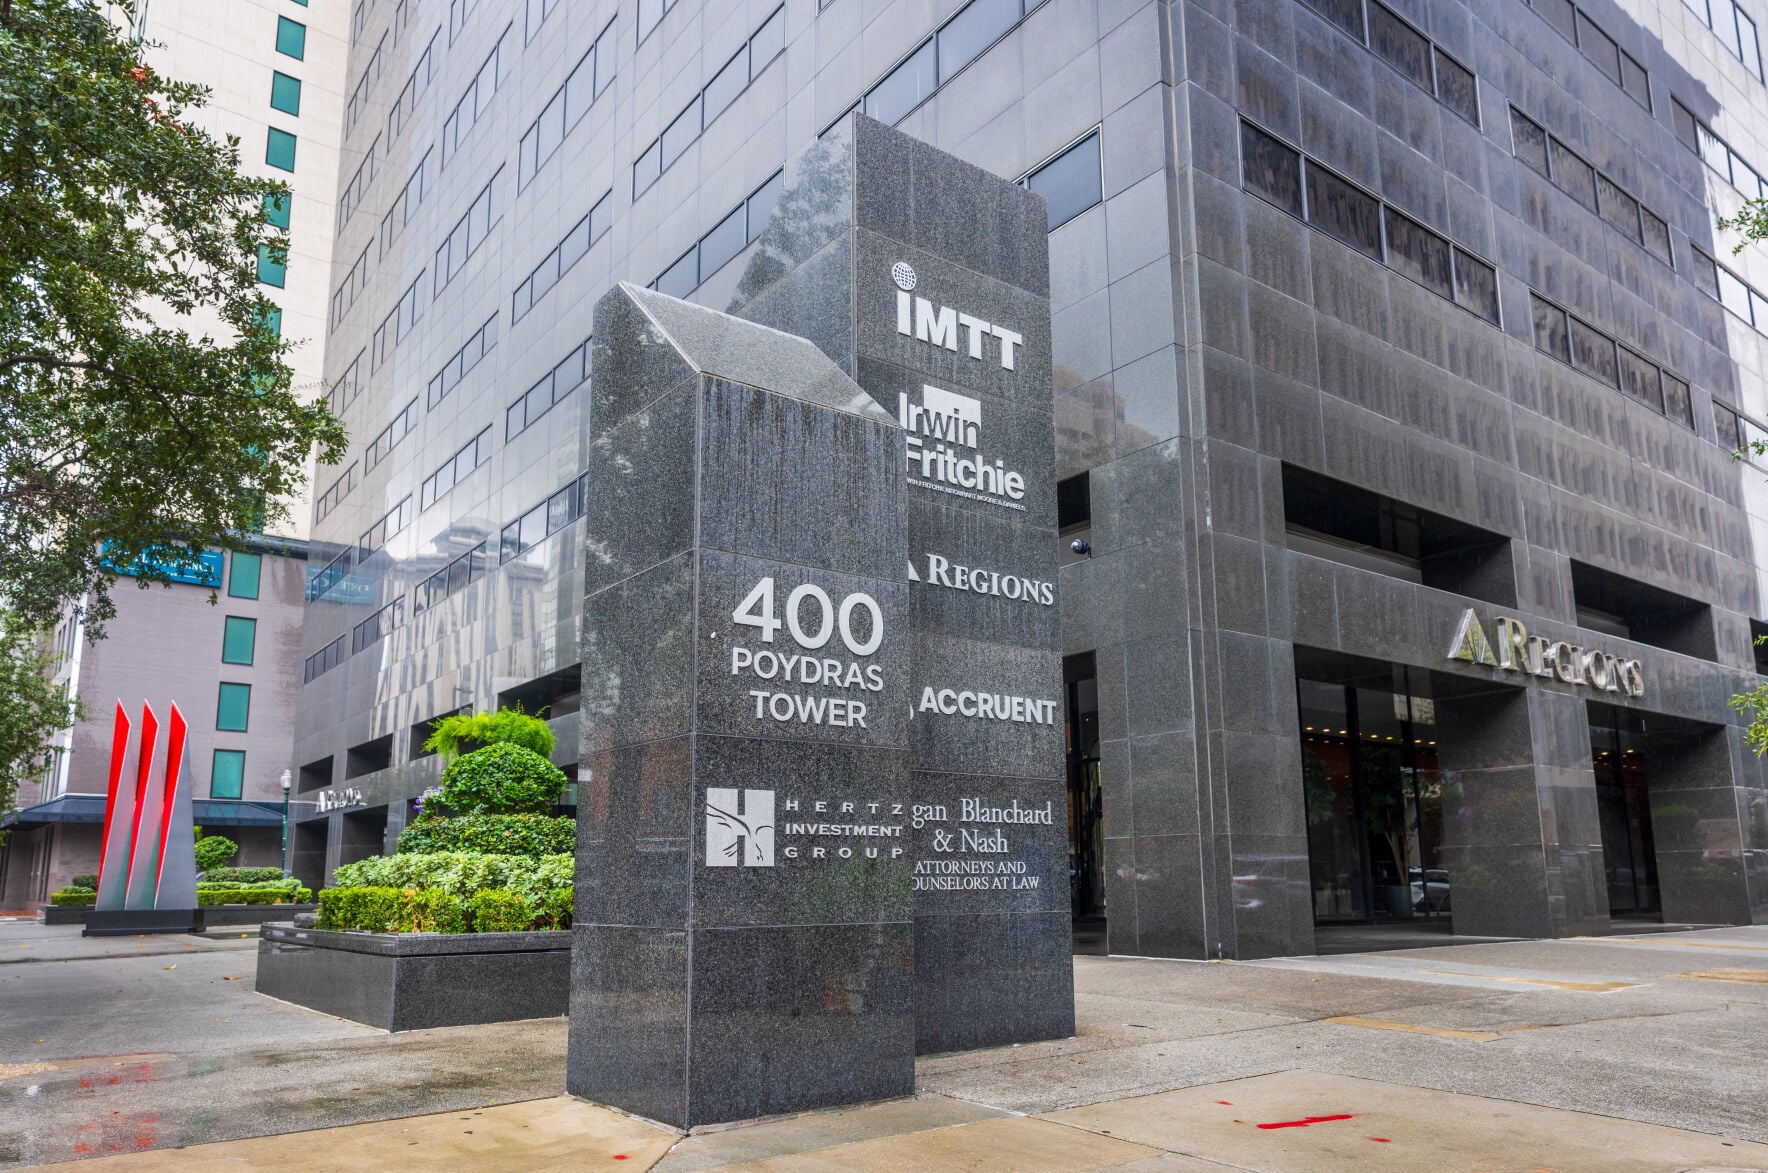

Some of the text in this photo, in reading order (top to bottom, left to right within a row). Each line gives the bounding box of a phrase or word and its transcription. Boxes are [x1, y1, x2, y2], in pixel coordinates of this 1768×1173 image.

[899, 391, 981, 449] Irwin
[906, 436, 1025, 500] Fritchie
[926, 553, 1054, 606] REGIONS
[732, 576, 884, 656] 400
[731, 646, 884, 692] POYDRAS
[1494, 615, 1645, 697] REGIONS
[749, 690, 867, 728] TOWER
[918, 686, 1057, 725] ACCRUENT
[784, 799, 903, 815] HERTZ
[912, 797, 1053, 829] gan Blanchard
[784, 823, 903, 837] INVESTMENT
[933, 828, 1009, 853] & Nash
[783, 846, 903, 859] GROUP
[914, 860, 1027, 874] ATTORNEYS AND
[911, 876, 1040, 891] OUNSELORS AT LAW
